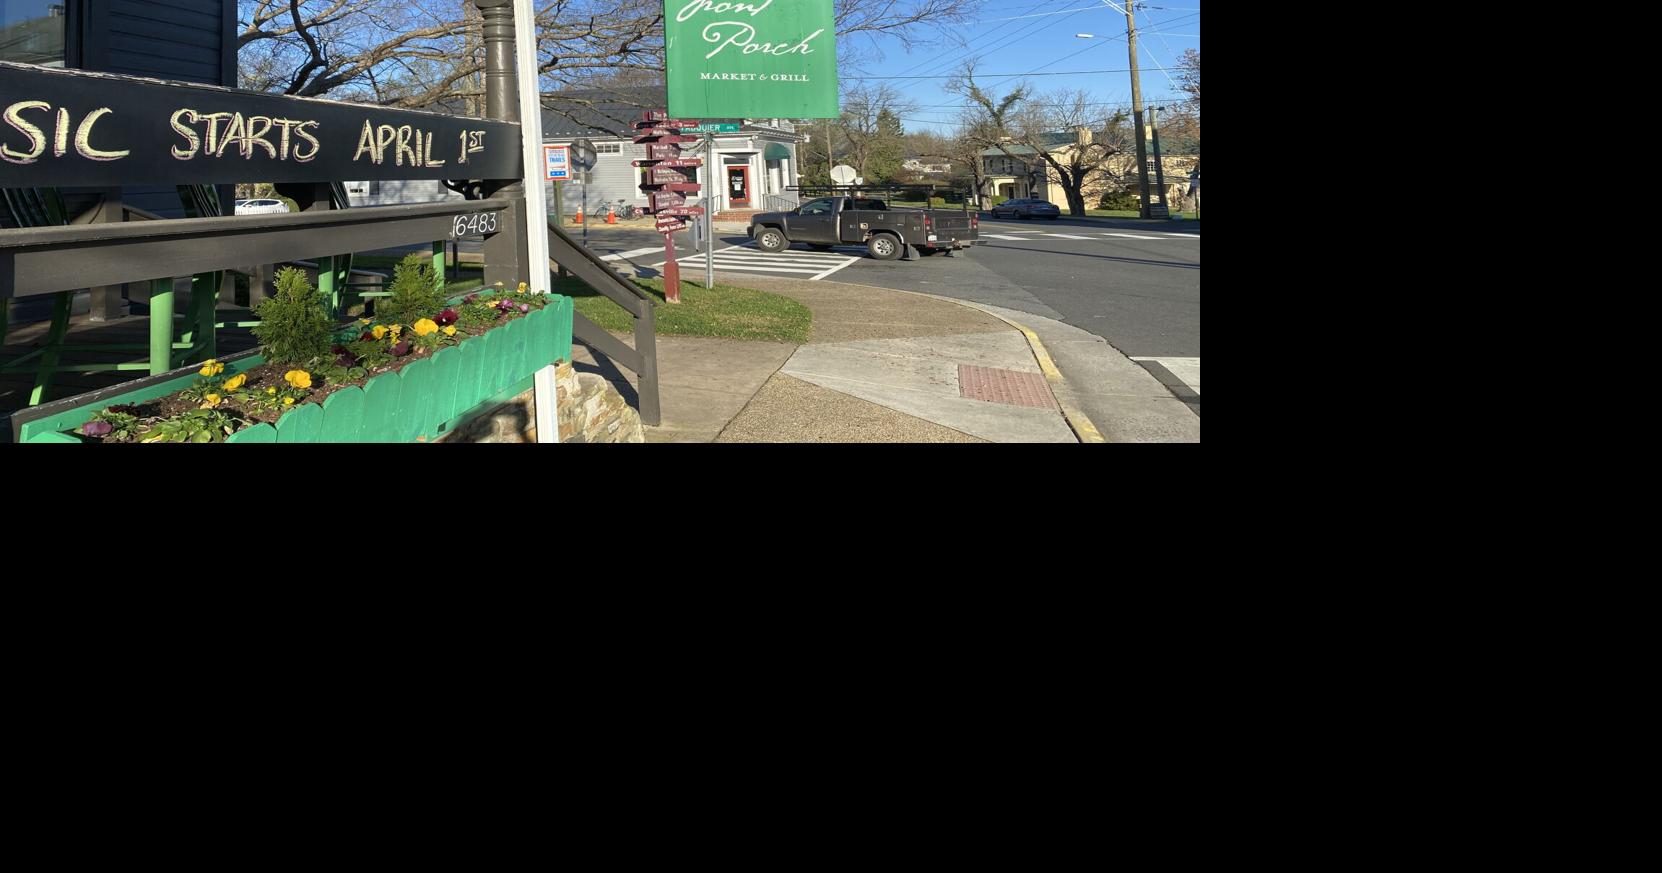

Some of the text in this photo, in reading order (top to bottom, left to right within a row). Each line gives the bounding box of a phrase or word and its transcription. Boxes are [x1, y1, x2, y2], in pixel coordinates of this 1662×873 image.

[702, 21, 824, 59] Porch
[700, 72, 809, 82] MARKET & GRILL
[170, 108, 320, 163] STARTS
[352, 119, 445, 168] APRIL
[458, 129, 486, 164] 1ST
